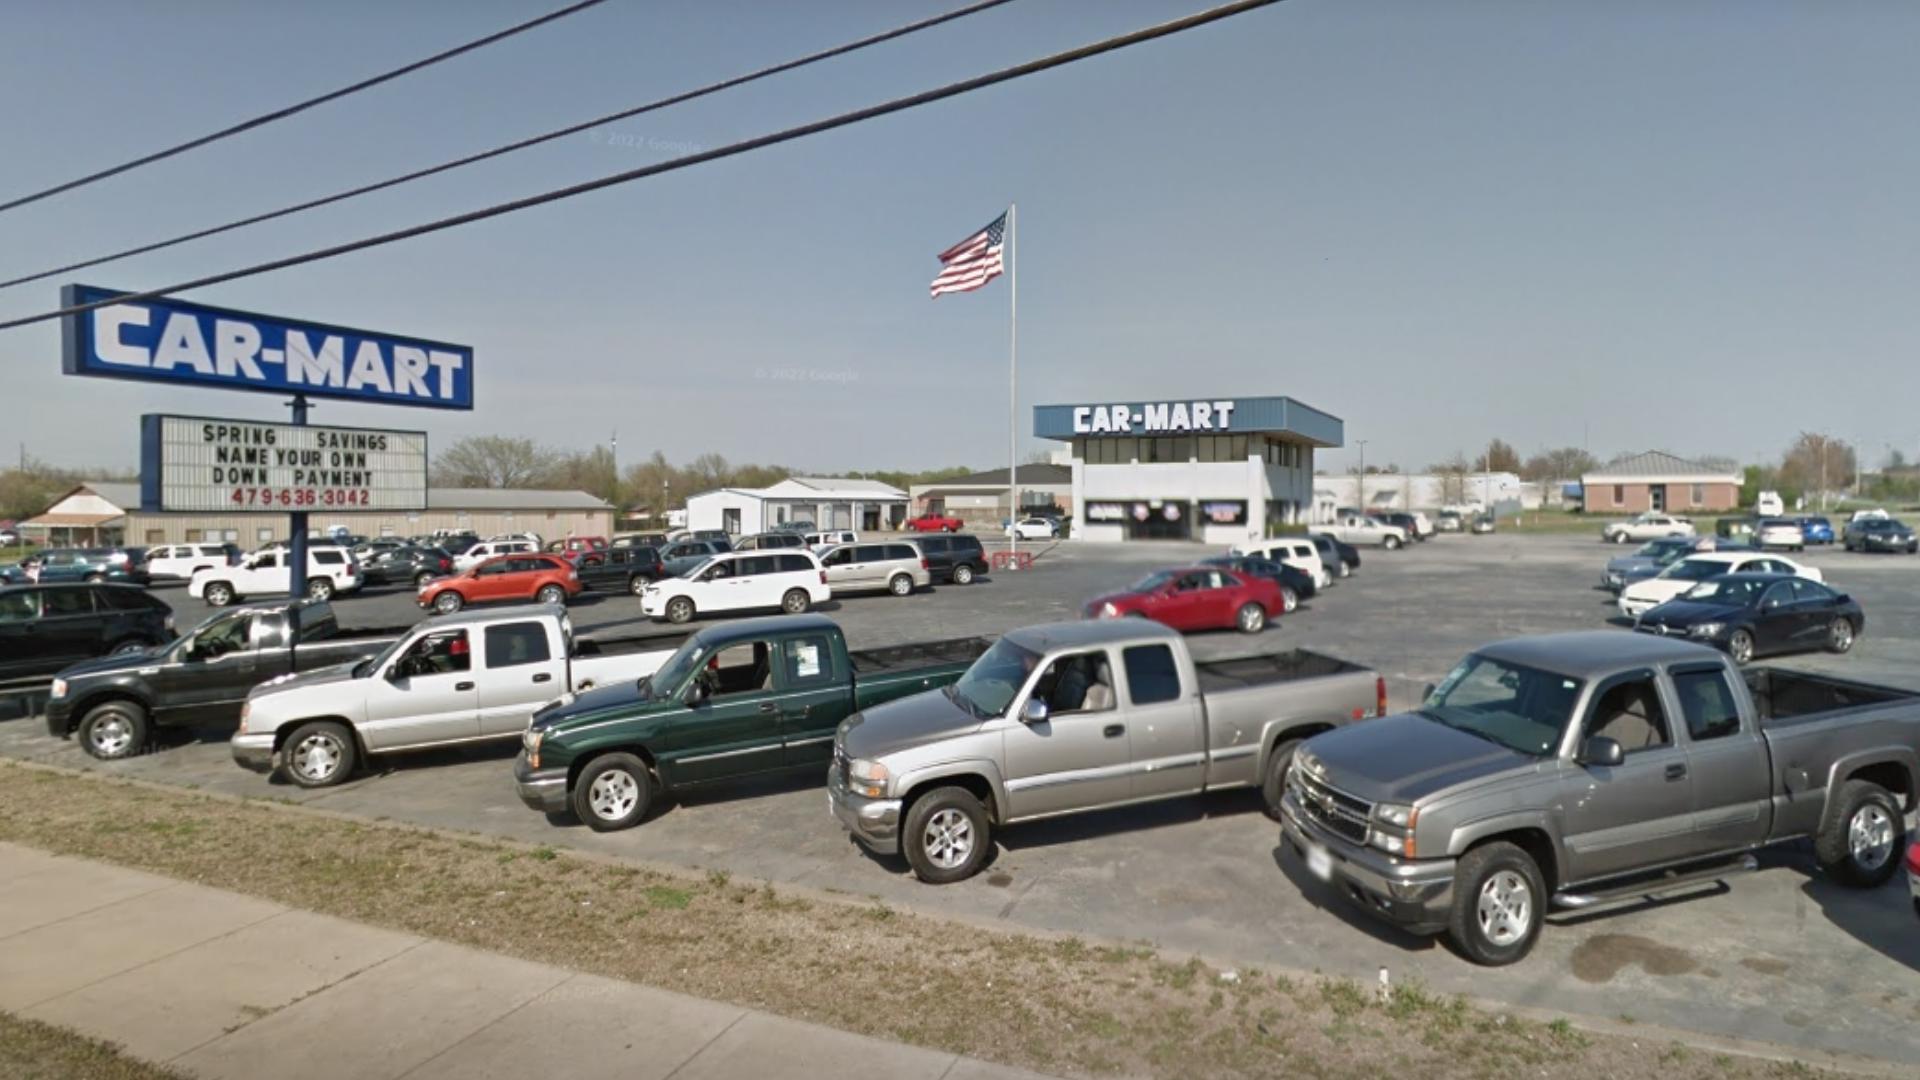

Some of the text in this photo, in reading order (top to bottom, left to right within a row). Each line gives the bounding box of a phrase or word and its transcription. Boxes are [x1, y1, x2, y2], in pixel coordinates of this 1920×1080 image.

[94, 303, 463, 400] CAR-MART
[1073, 401, 1235, 433] CAR-MART
[203, 424, 387, 451] SPRING SAVINGS
[216, 446, 367, 468] NAME YOUR OWN
[213, 466, 372, 487] DOWN PAYMENT
[231, 487, 370, 506] 479-636-3042
